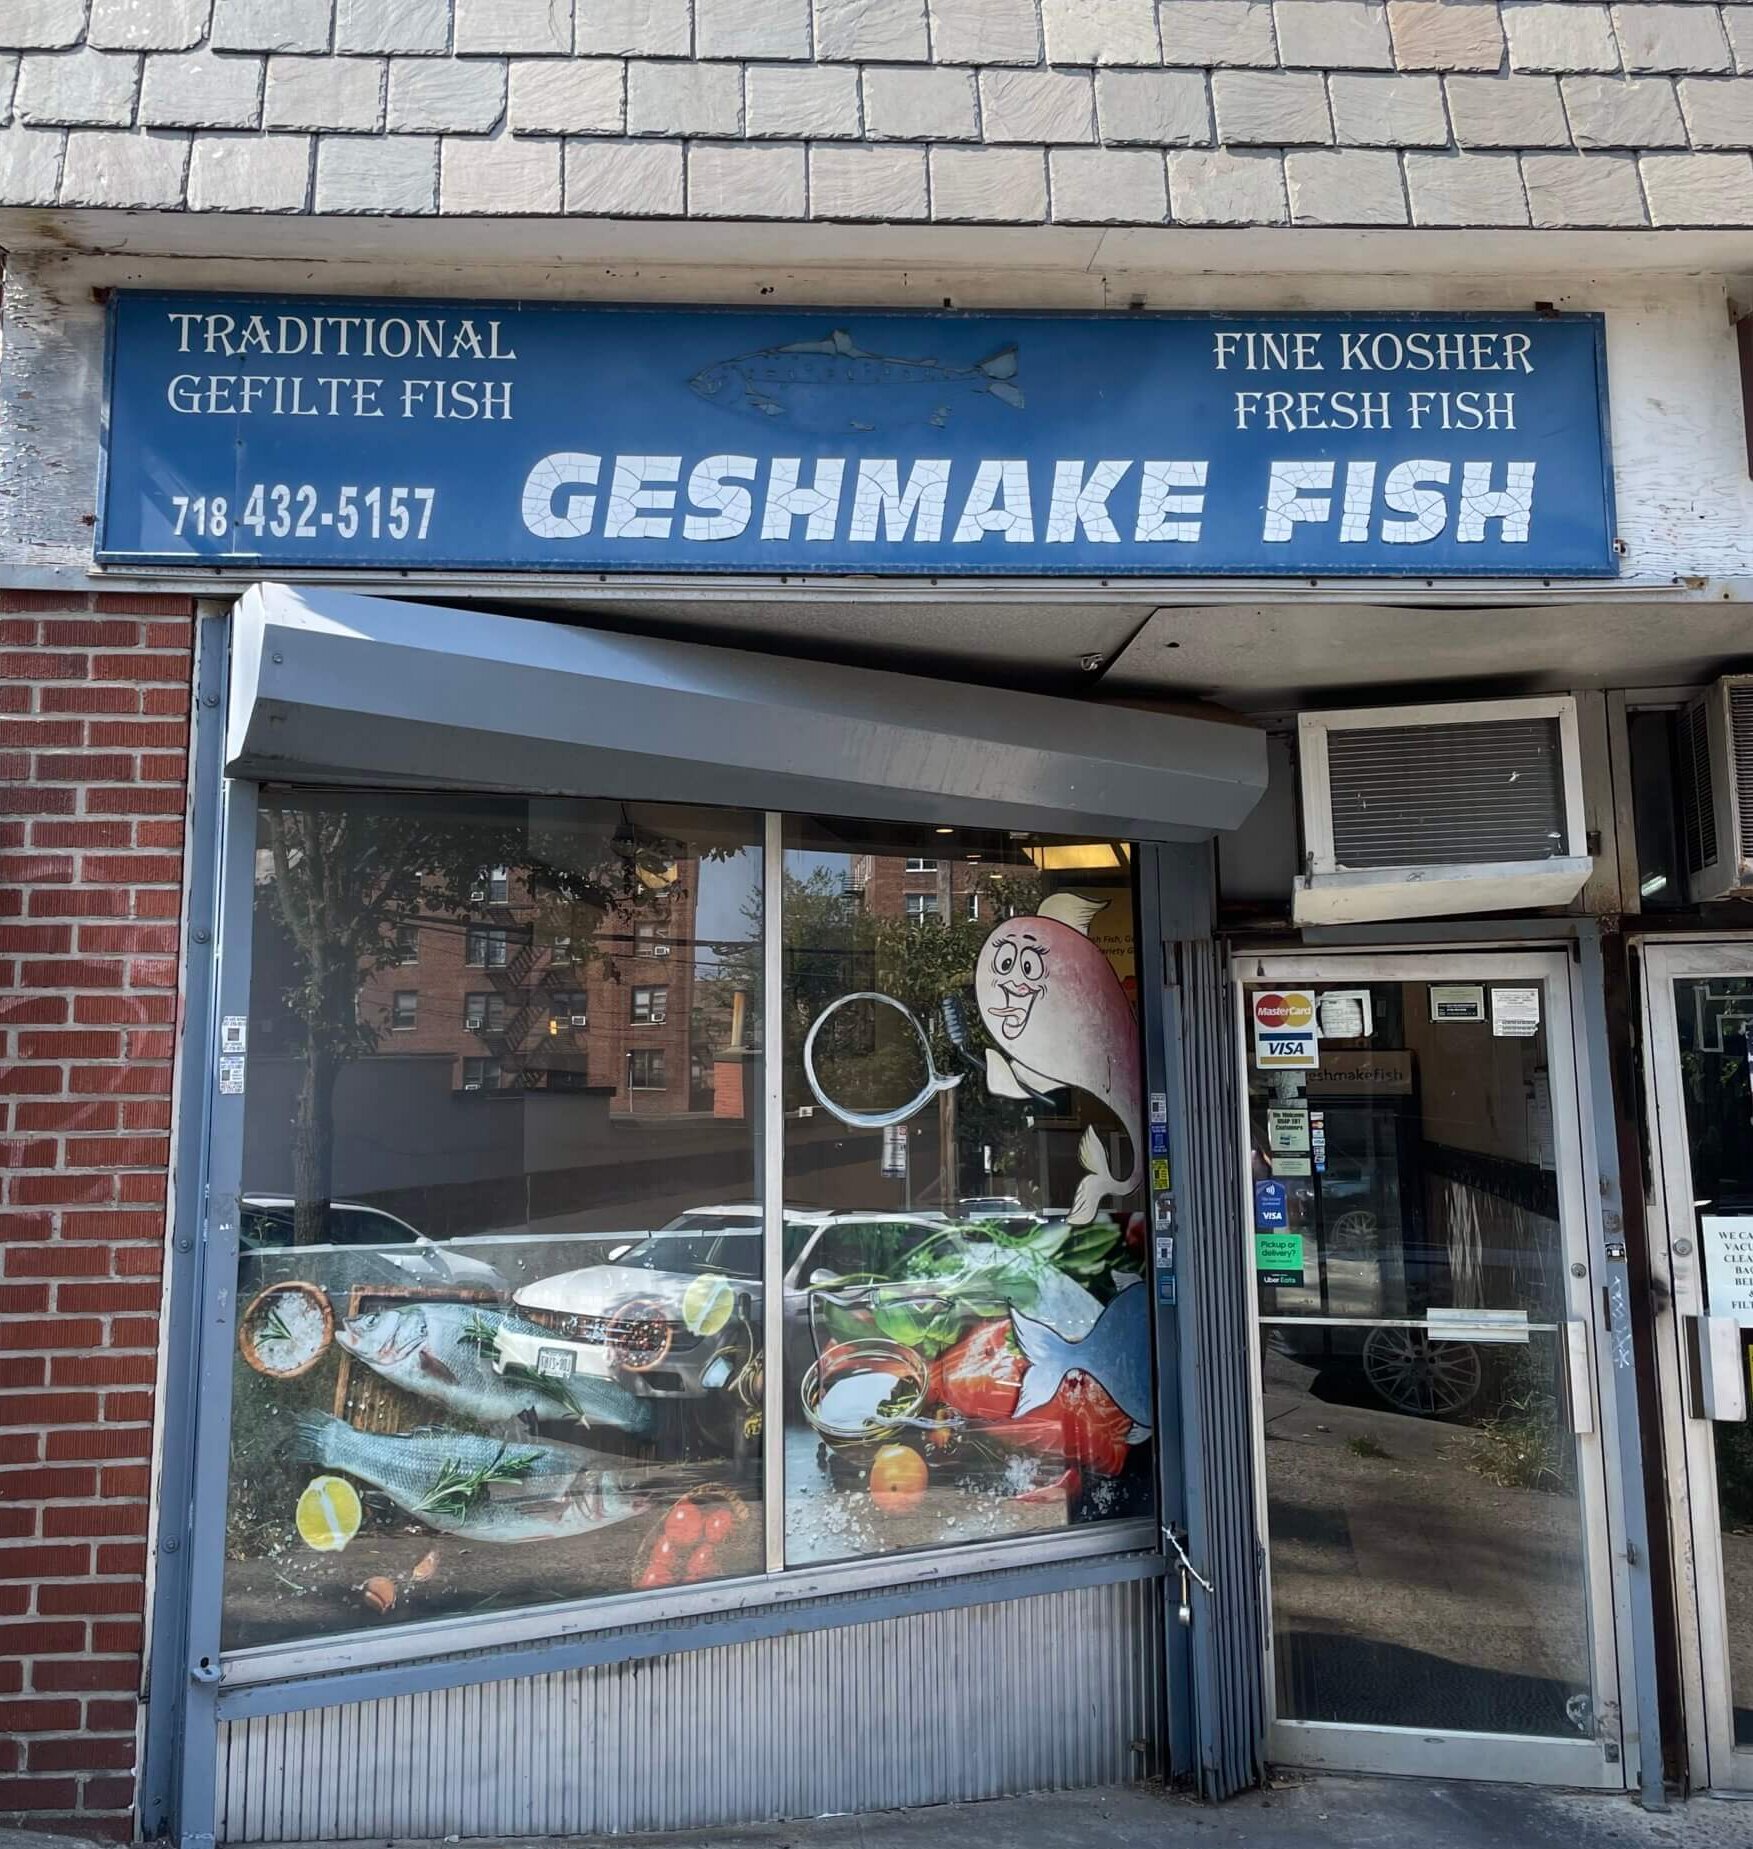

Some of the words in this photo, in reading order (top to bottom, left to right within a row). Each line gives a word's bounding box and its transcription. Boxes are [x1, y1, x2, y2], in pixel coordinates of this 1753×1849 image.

[168, 313, 516, 359] TRADITIONAL
[1212, 333, 1322, 370] FINE
[1340, 333, 1535, 374] KOSHER
[167, 374, 385, 417] GEFILTE
[401, 379, 513, 420] FISH
[1234, 391, 1391, 432] FRESH
[1407, 391, 1516, 430] FISH
[521, 452, 1209, 543] GESHMAKE
[1261, 460, 1536, 543] FISH
[172, 496, 228, 537] 718
[243, 484, 436, 540] 432-5157
[1257, 1006, 1312, 1016] MasterCard
[1268, 1042, 1305, 1055] VISA
[1306, 1068, 1403, 1081] eshmakefish
[1263, 1212, 1282, 1220] VISA
[1718, 1232, 1736, 1240] WE
[1260, 1241, 1287, 1250] Pickup
[1261, 1249, 1296, 1258] delivery?
[1264, 1276, 1280, 1284] Uber
[1280, 1276, 1296, 1284] Eats
